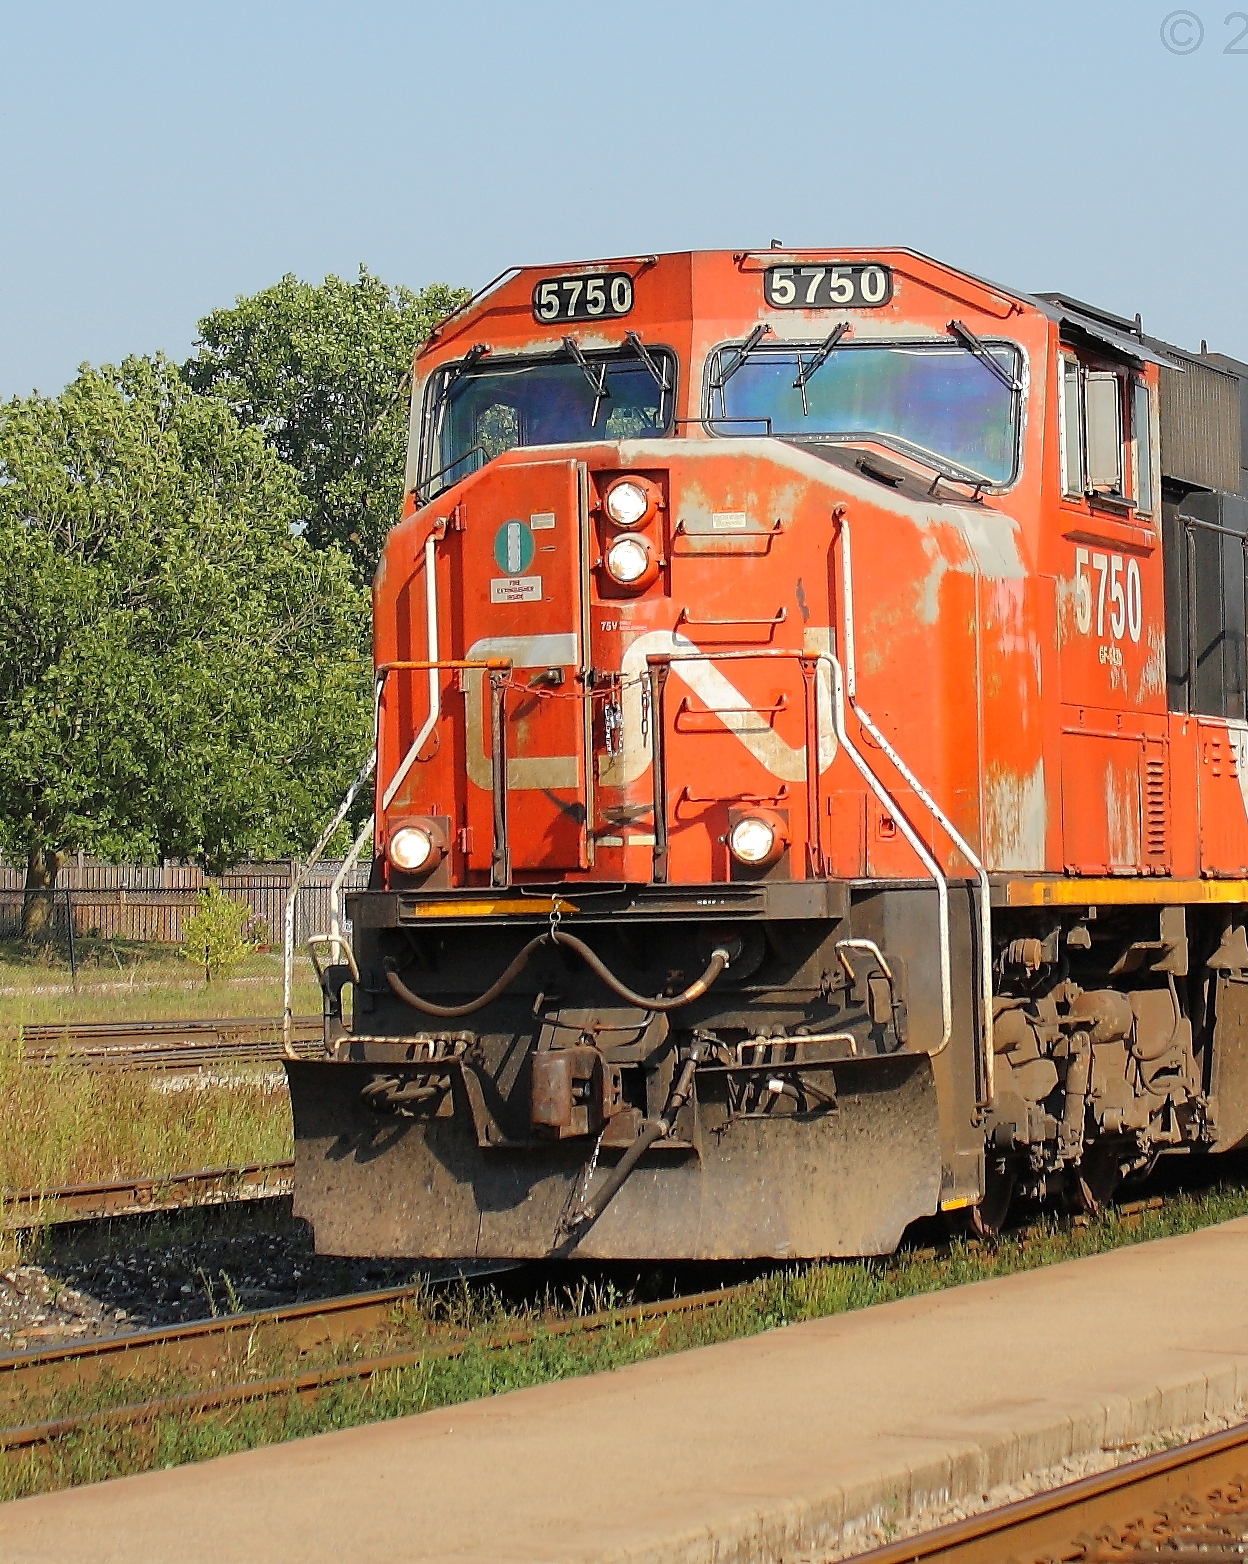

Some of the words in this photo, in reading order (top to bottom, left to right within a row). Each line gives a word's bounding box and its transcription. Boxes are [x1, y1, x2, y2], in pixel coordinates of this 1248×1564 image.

[538, 276, 632, 318] 5750
[771, 266, 887, 303] 5750
[1075, 546, 1142, 643] 5750
[600, 621, 619, 631] 75V
[465, 627, 838, 791] CN
